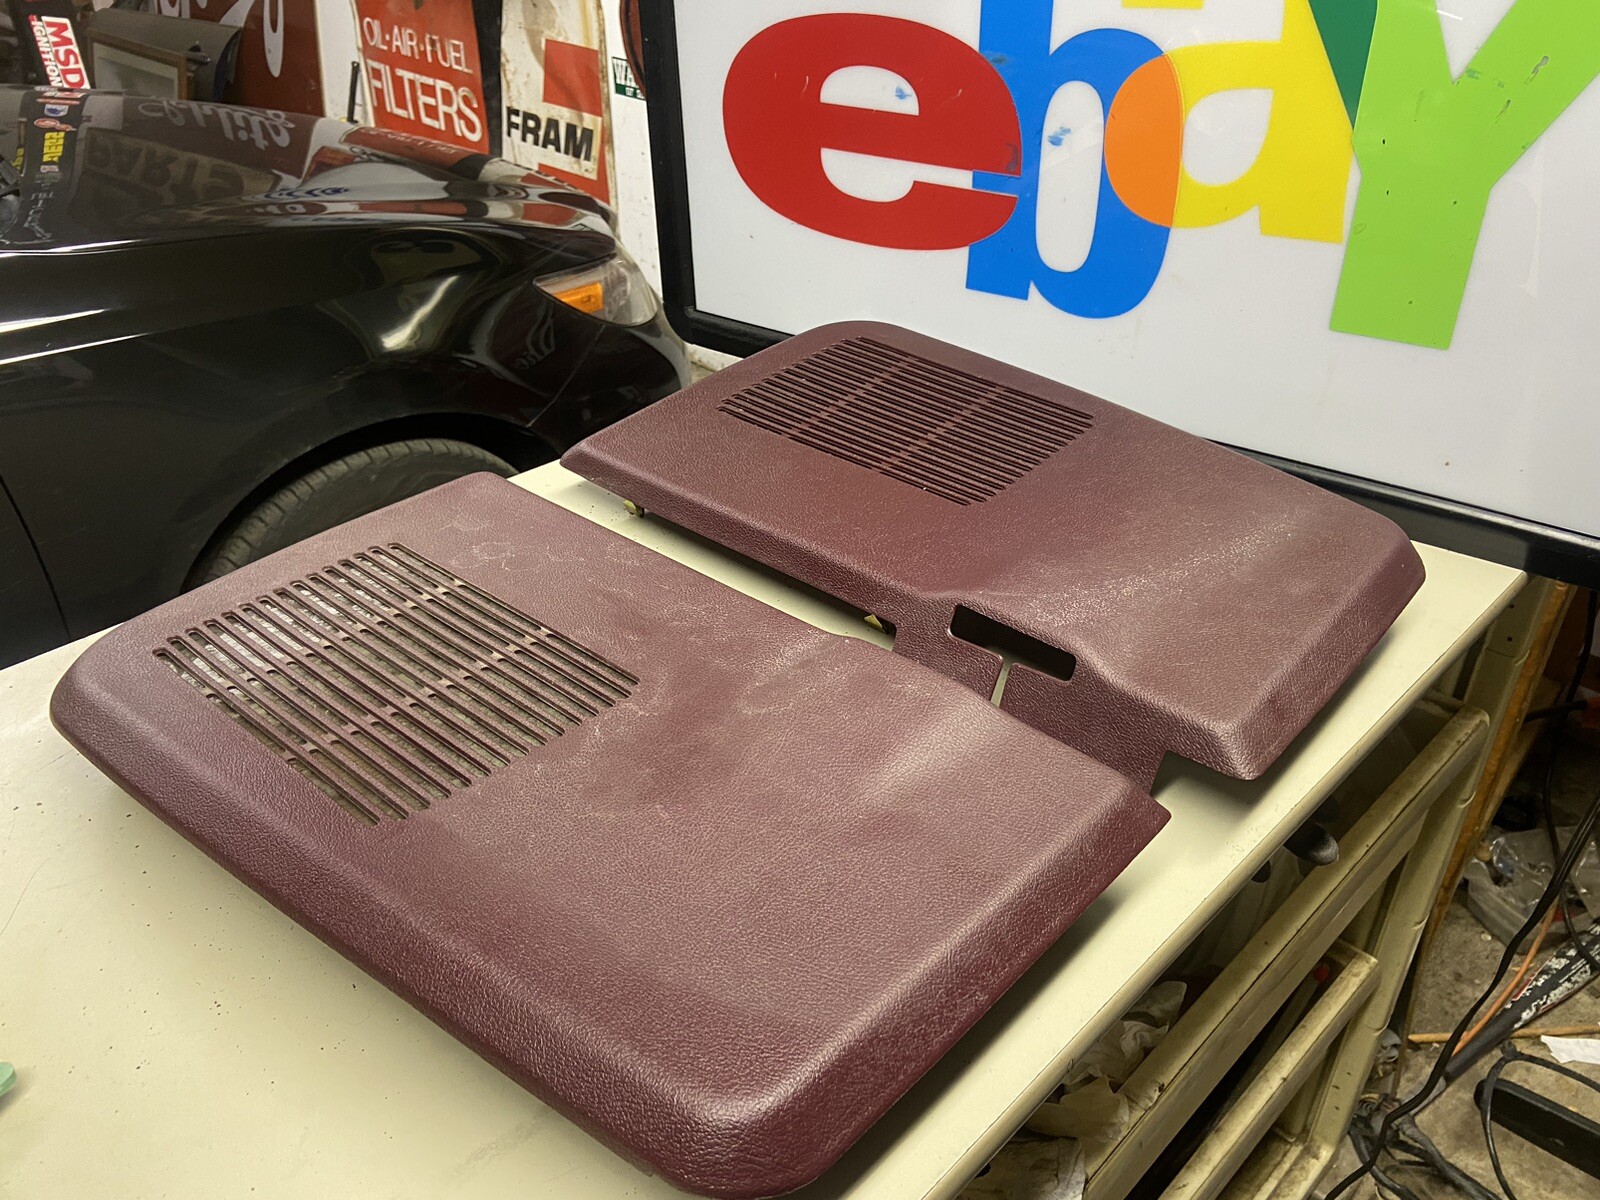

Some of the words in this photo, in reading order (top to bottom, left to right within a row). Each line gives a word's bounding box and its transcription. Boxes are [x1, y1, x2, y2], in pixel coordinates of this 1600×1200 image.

[31, 20, 63, 87] IGNITION
[44, 20, 86, 88] MSD
[366, 58, 483, 142] FILTERS
[506, 106, 595, 162] FRAM
